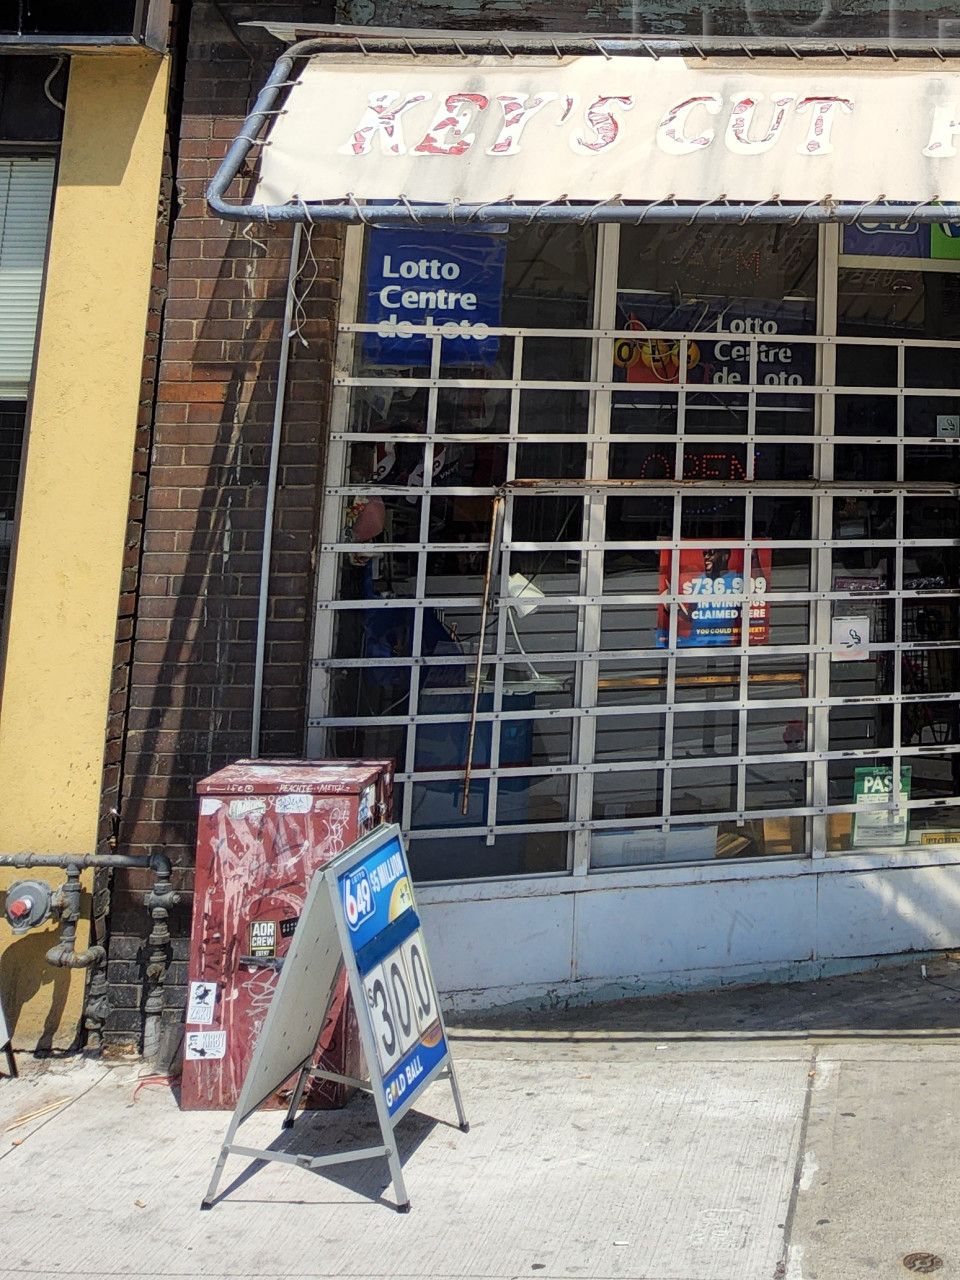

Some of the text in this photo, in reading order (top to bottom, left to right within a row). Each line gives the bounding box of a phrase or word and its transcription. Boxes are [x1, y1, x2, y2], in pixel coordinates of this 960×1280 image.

[338, 89, 636, 158] KEY'S
[658, 91, 855, 156] CUT
[382, 255, 461, 280] Lotto
[379, 285, 477, 310] Centre
[377, 314, 413, 338] de
[716, 314, 778, 336] Lotto
[713, 366, 803, 386] de oto
[691, 608, 738, 619] CLAIMED
[345, 878, 371, 925] 649
[251, 936, 275, 947] CREW
[252, 922, 275, 937] AOR
[406, 1055, 424, 1085] BALL
